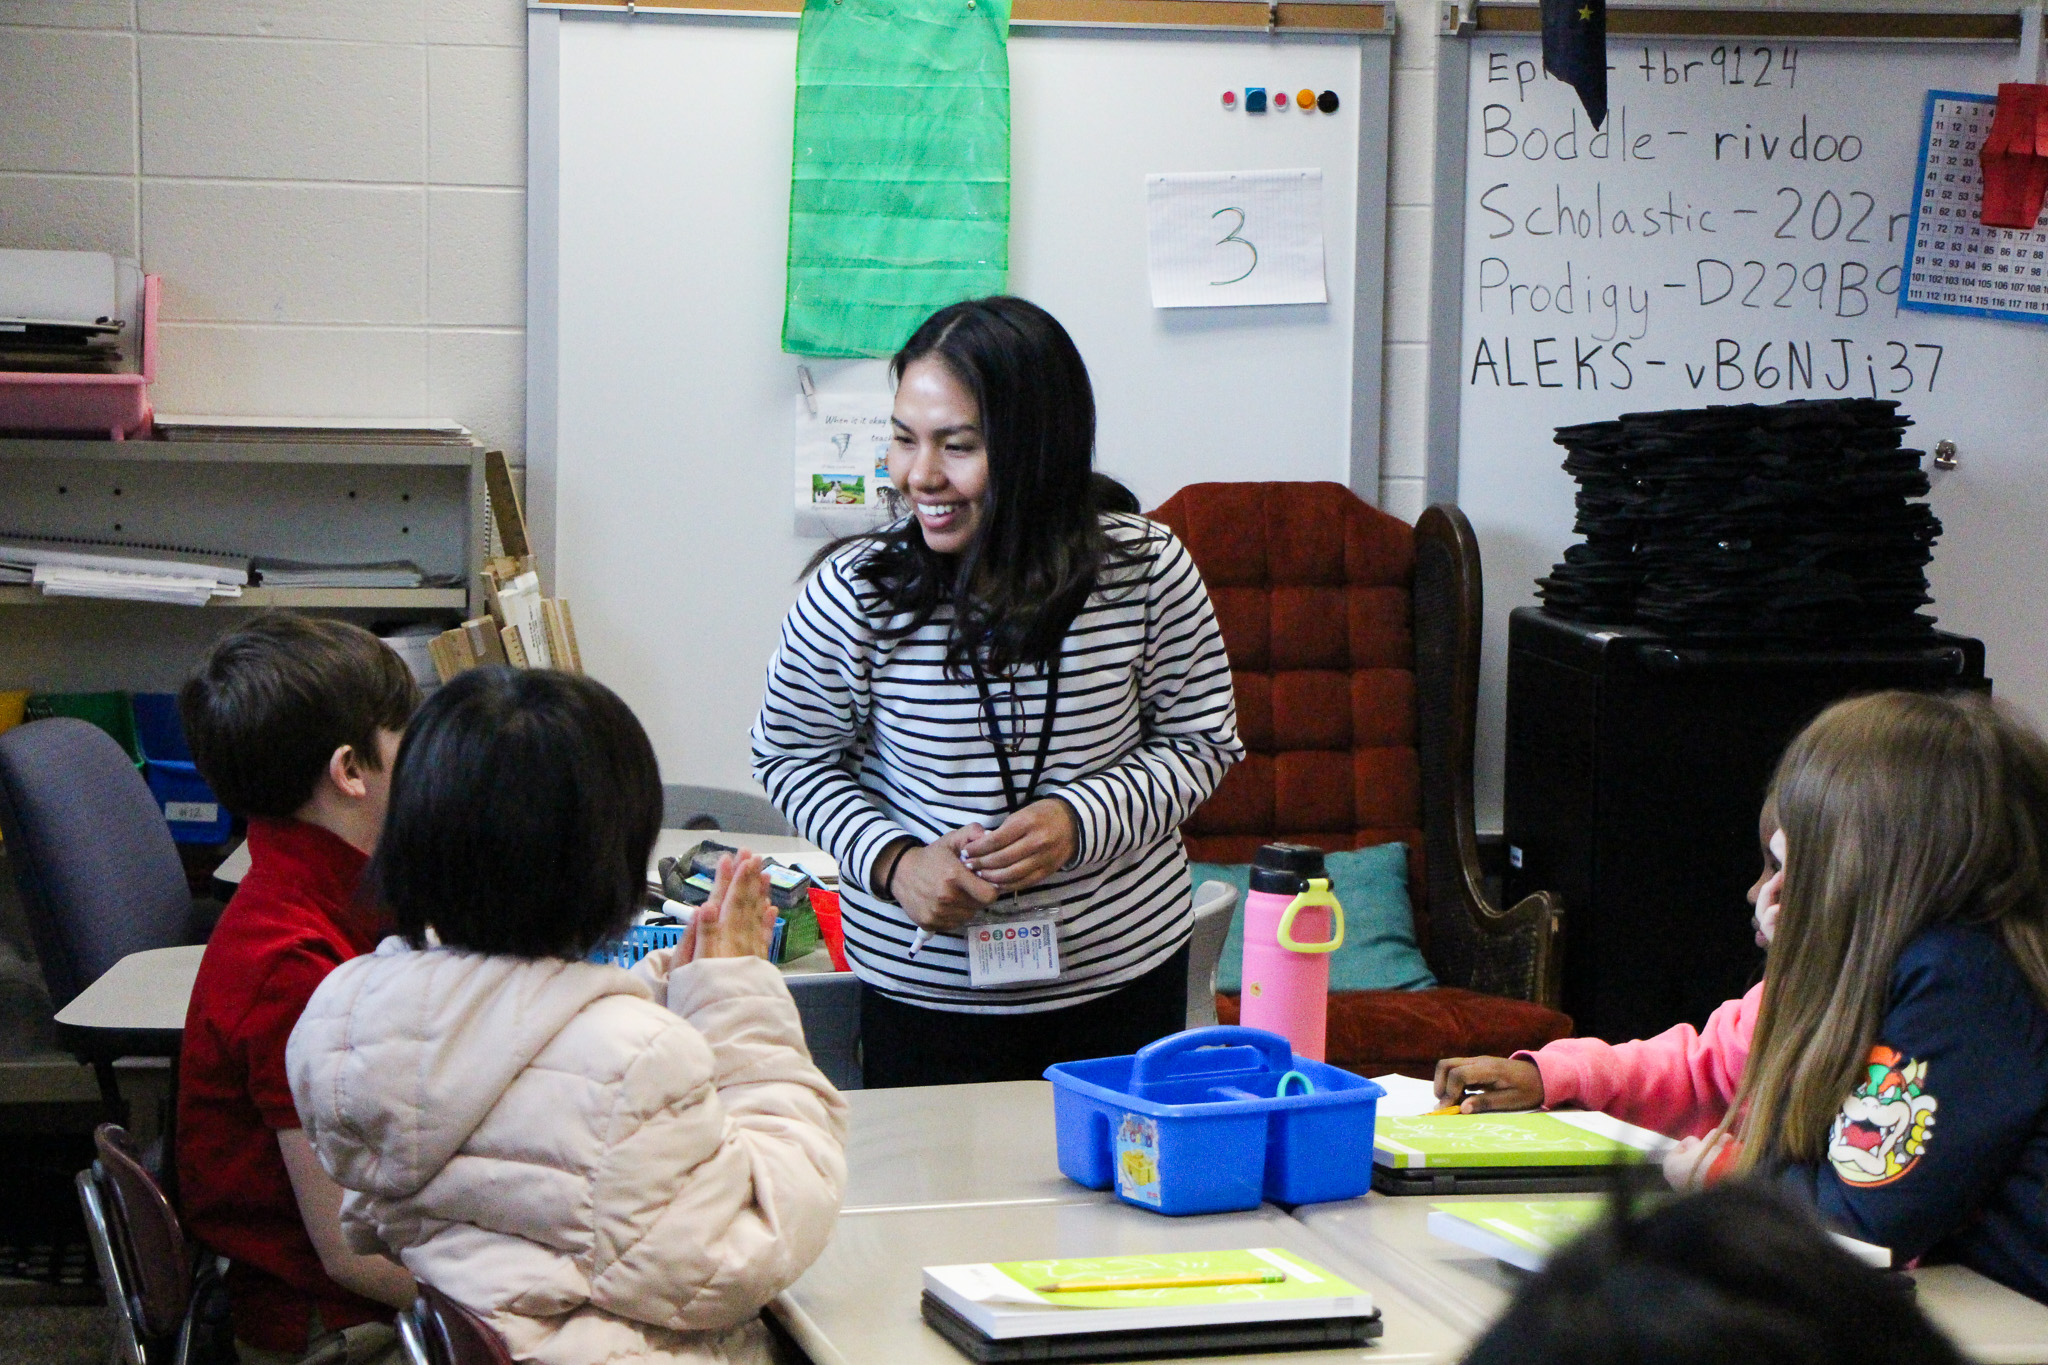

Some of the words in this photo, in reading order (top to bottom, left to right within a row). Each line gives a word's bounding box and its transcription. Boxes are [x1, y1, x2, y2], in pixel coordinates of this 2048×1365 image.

[1935, 121, 1944, 129] 11
[1952, 123, 1962, 131] 12
[1969, 124, 1978, 133] 13
[1715, 114, 1863, 162] rivdoo
[1932, 138, 1942, 147] 21
[1949, 140, 1959, 148] 22
[1965, 141, 1976, 150] 23
[1929, 155, 1940, 163] 31
[1946, 156, 1957, 165] 32
[1963, 158, 1973, 167] 33
[1927, 172, 1937, 180] 41
[1944, 174, 1955, 182] 42
[1961, 175, 1971, 183] 43
[1925, 189, 1934, 197] 51
[1941, 190, 1952, 199] 52
[1958, 192, 1969, 200] 53
[1922, 206, 1932, 214] 61
[1939, 207, 1950, 216] 62
[1956, 209, 1966, 218] 63
[1920, 222, 1930, 231] 71
[1937, 224, 1947, 233] 72
[1954, 226, 1964, 234] 73
[1970, 227, 1980, 236] 74
[1987, 229, 1997, 238] 75
[2003, 231, 2013, 239] 76
[2020, 232, 2030, 240] 77
[2036, 233, 2046, 242] 78
[1208, 206, 1258, 286] 3
[1918, 240, 1927, 248] 81
[1934, 241, 1945, 250] 82
[1951, 243, 1962, 251] 83
[1967, 244, 1978, 253] 84
[1984, 246, 1994, 255] 85
[2000, 248, 2011, 256] 86
[2016, 249, 2027, 258] 87
[2033, 251, 2043, 259] 88
[1915, 256, 1925, 264] 91
[1932, 258, 1943, 266] 92
[1949, 260, 1959, 268] 93
[1965, 261, 1976, 269] 94
[1982, 263, 1992, 271] 95
[1998, 264, 2008, 273] 96
[2014, 266, 2025, 275] 97
[2031, 268, 2041, 276] 98
[1912, 273, 1925, 281] 101
[1928, 274, 1942, 284] 102
[1945, 276, 1959, 285] 103
[1961, 278, 1975, 287] 104
[1978, 280, 1992, 288] 105
[1994, 281, 2008, 290] 106
[2011, 283, 2025, 292] 107
[2027, 284, 2041, 294] 108
[1910, 290, 1922, 298] 111
[1926, 291, 1940, 300] 112
[1943, 293, 1956, 302] 113
[1960, 295, 1972, 304] 114
[1976, 296, 1988, 306] 115
[1992, 298, 2005, 307] 116
[2008, 299, 2021, 308] 117
[2025, 301, 2038, 310] 118
